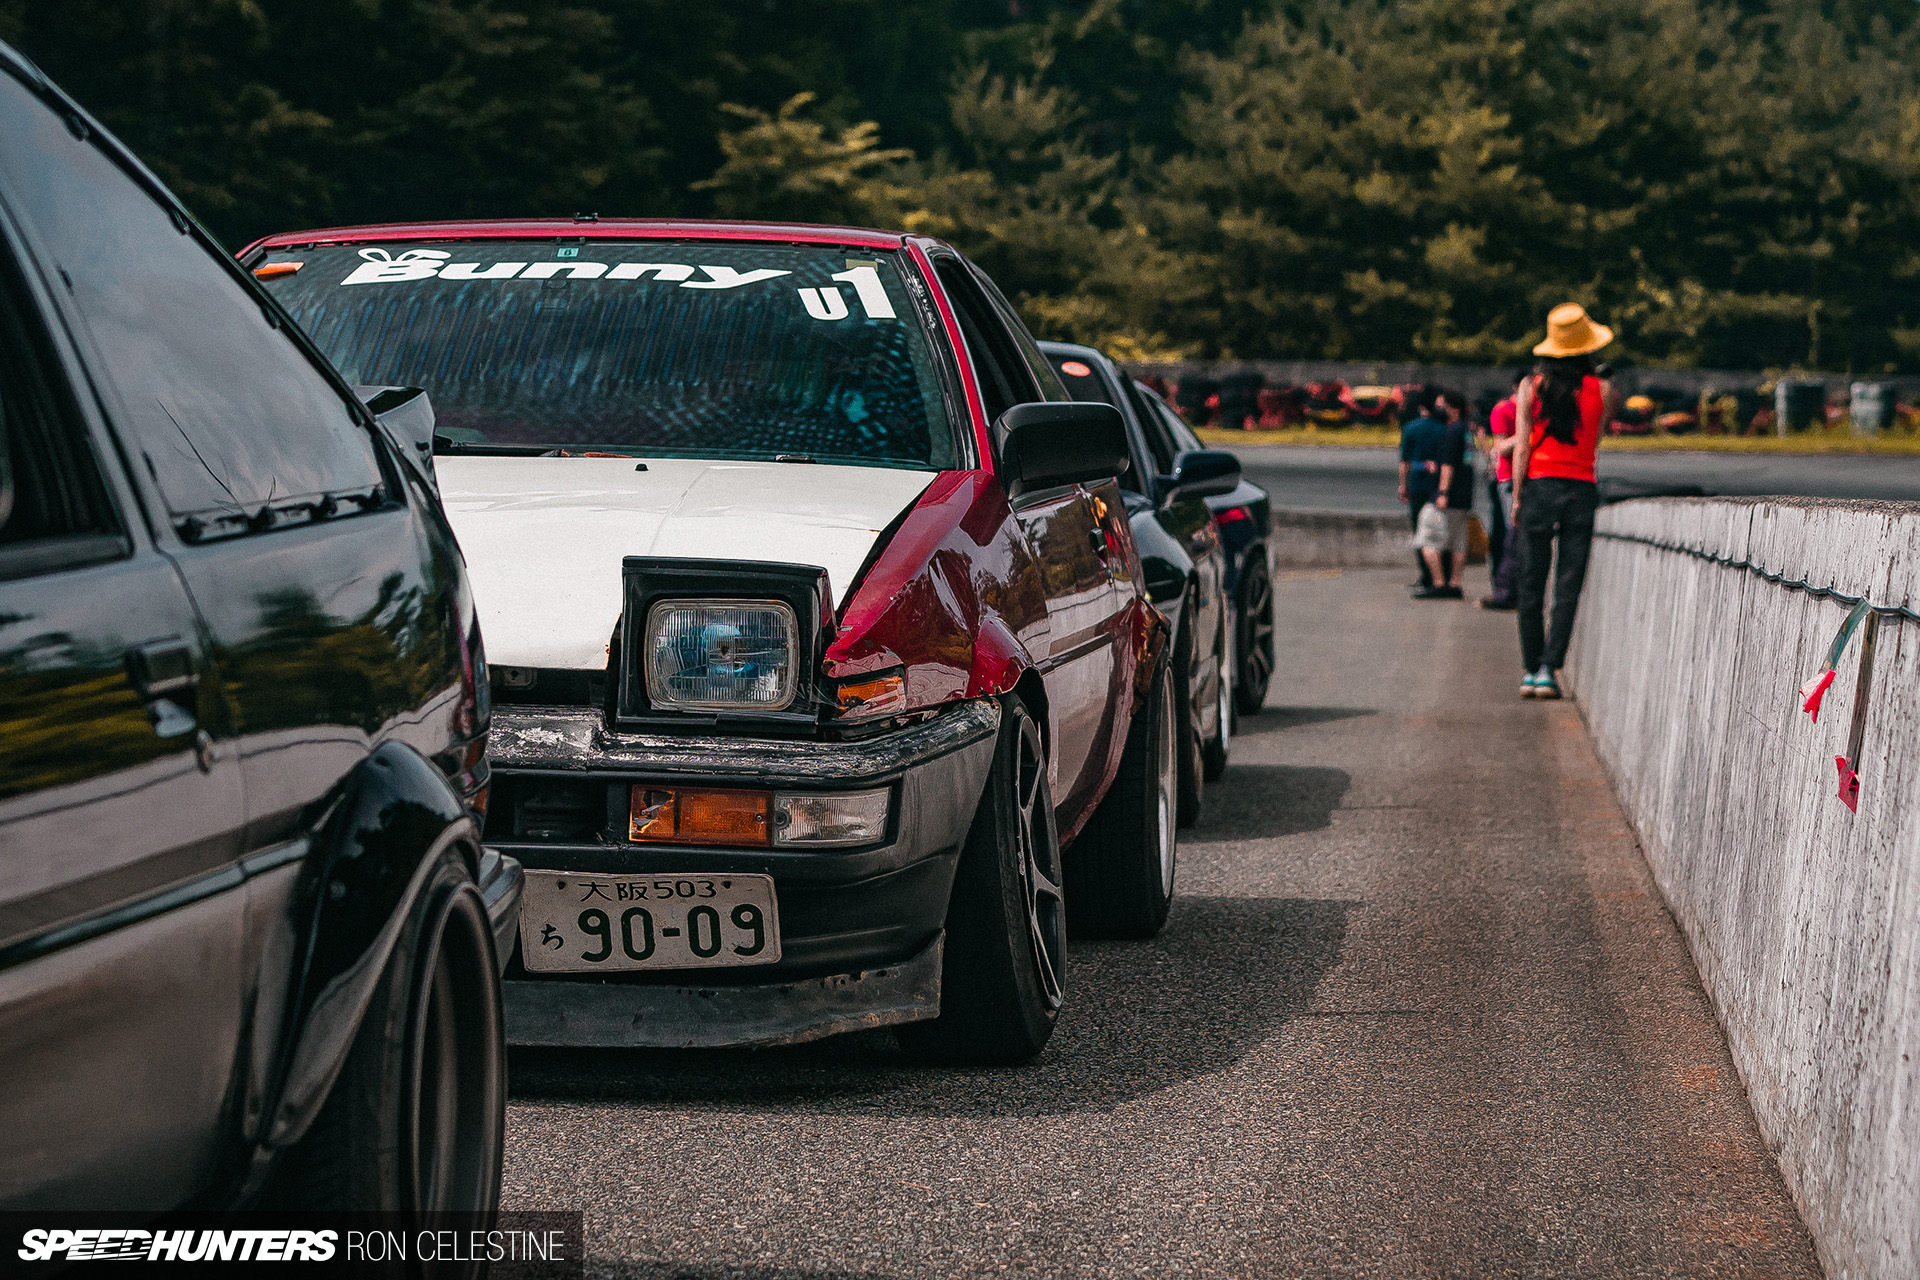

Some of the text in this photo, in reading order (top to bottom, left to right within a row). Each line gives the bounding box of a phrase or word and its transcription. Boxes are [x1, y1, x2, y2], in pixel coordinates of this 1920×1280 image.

[341, 248, 793, 289] Bunny
[540, 903, 765, 962] ち 90-09
